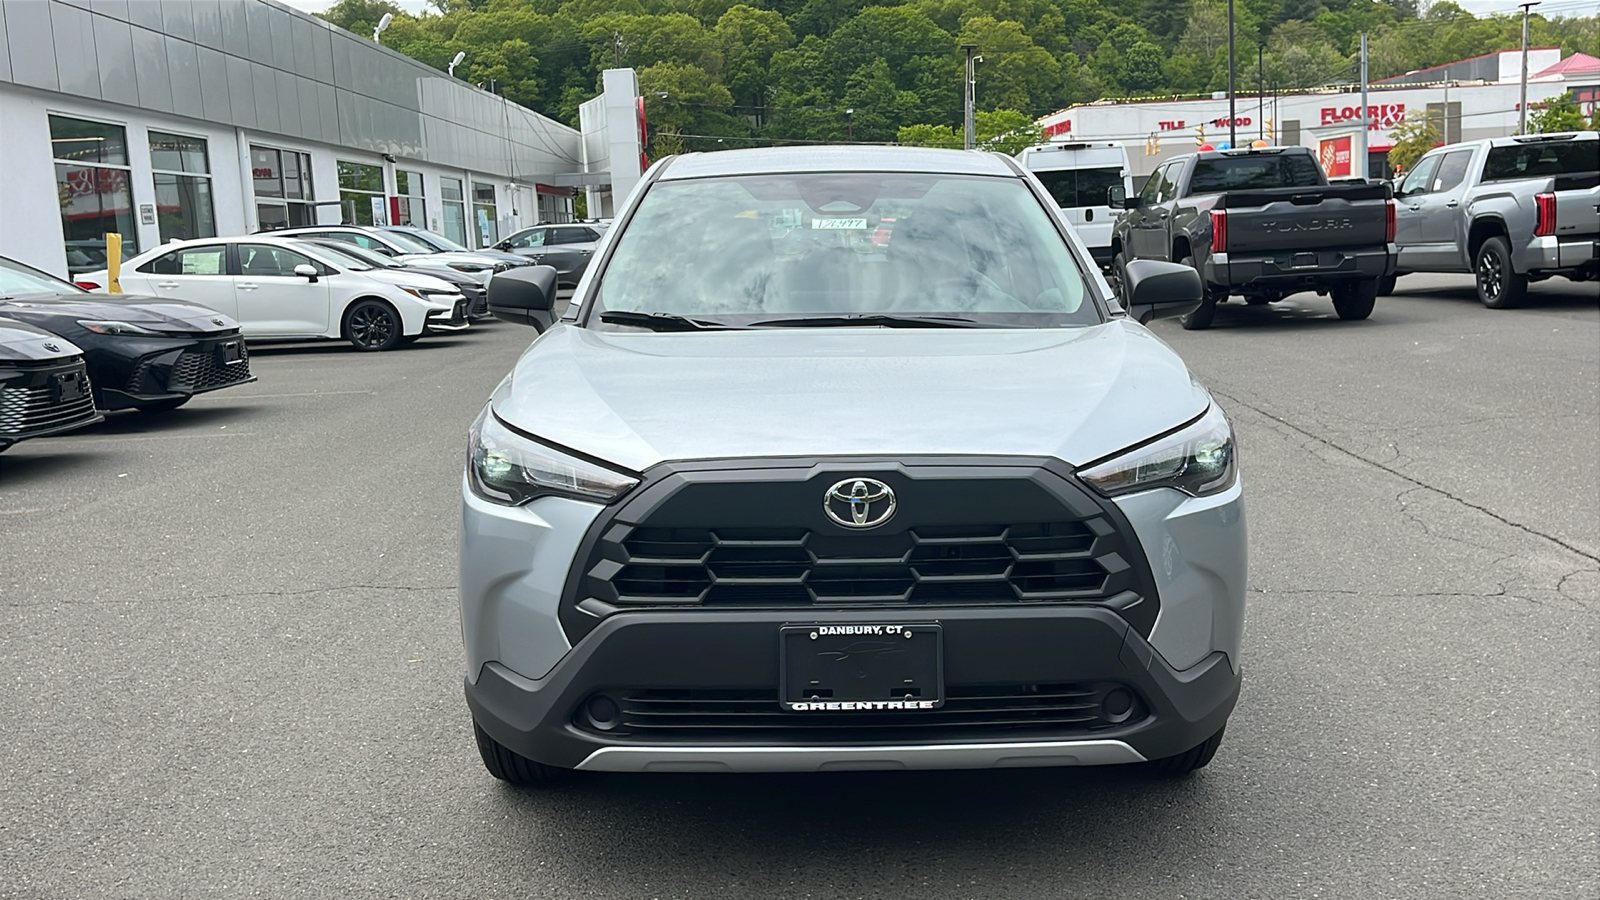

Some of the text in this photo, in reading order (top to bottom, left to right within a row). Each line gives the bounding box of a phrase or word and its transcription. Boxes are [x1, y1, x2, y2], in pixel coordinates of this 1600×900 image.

[1158, 120, 1185, 130] TILE
[1214, 117, 1252, 128] WOOD
[1262, 218, 1354, 233] TUNDRA
[819, 625, 903, 636] DANBURY, CT
[791, 701, 934, 711] GREENTREE
